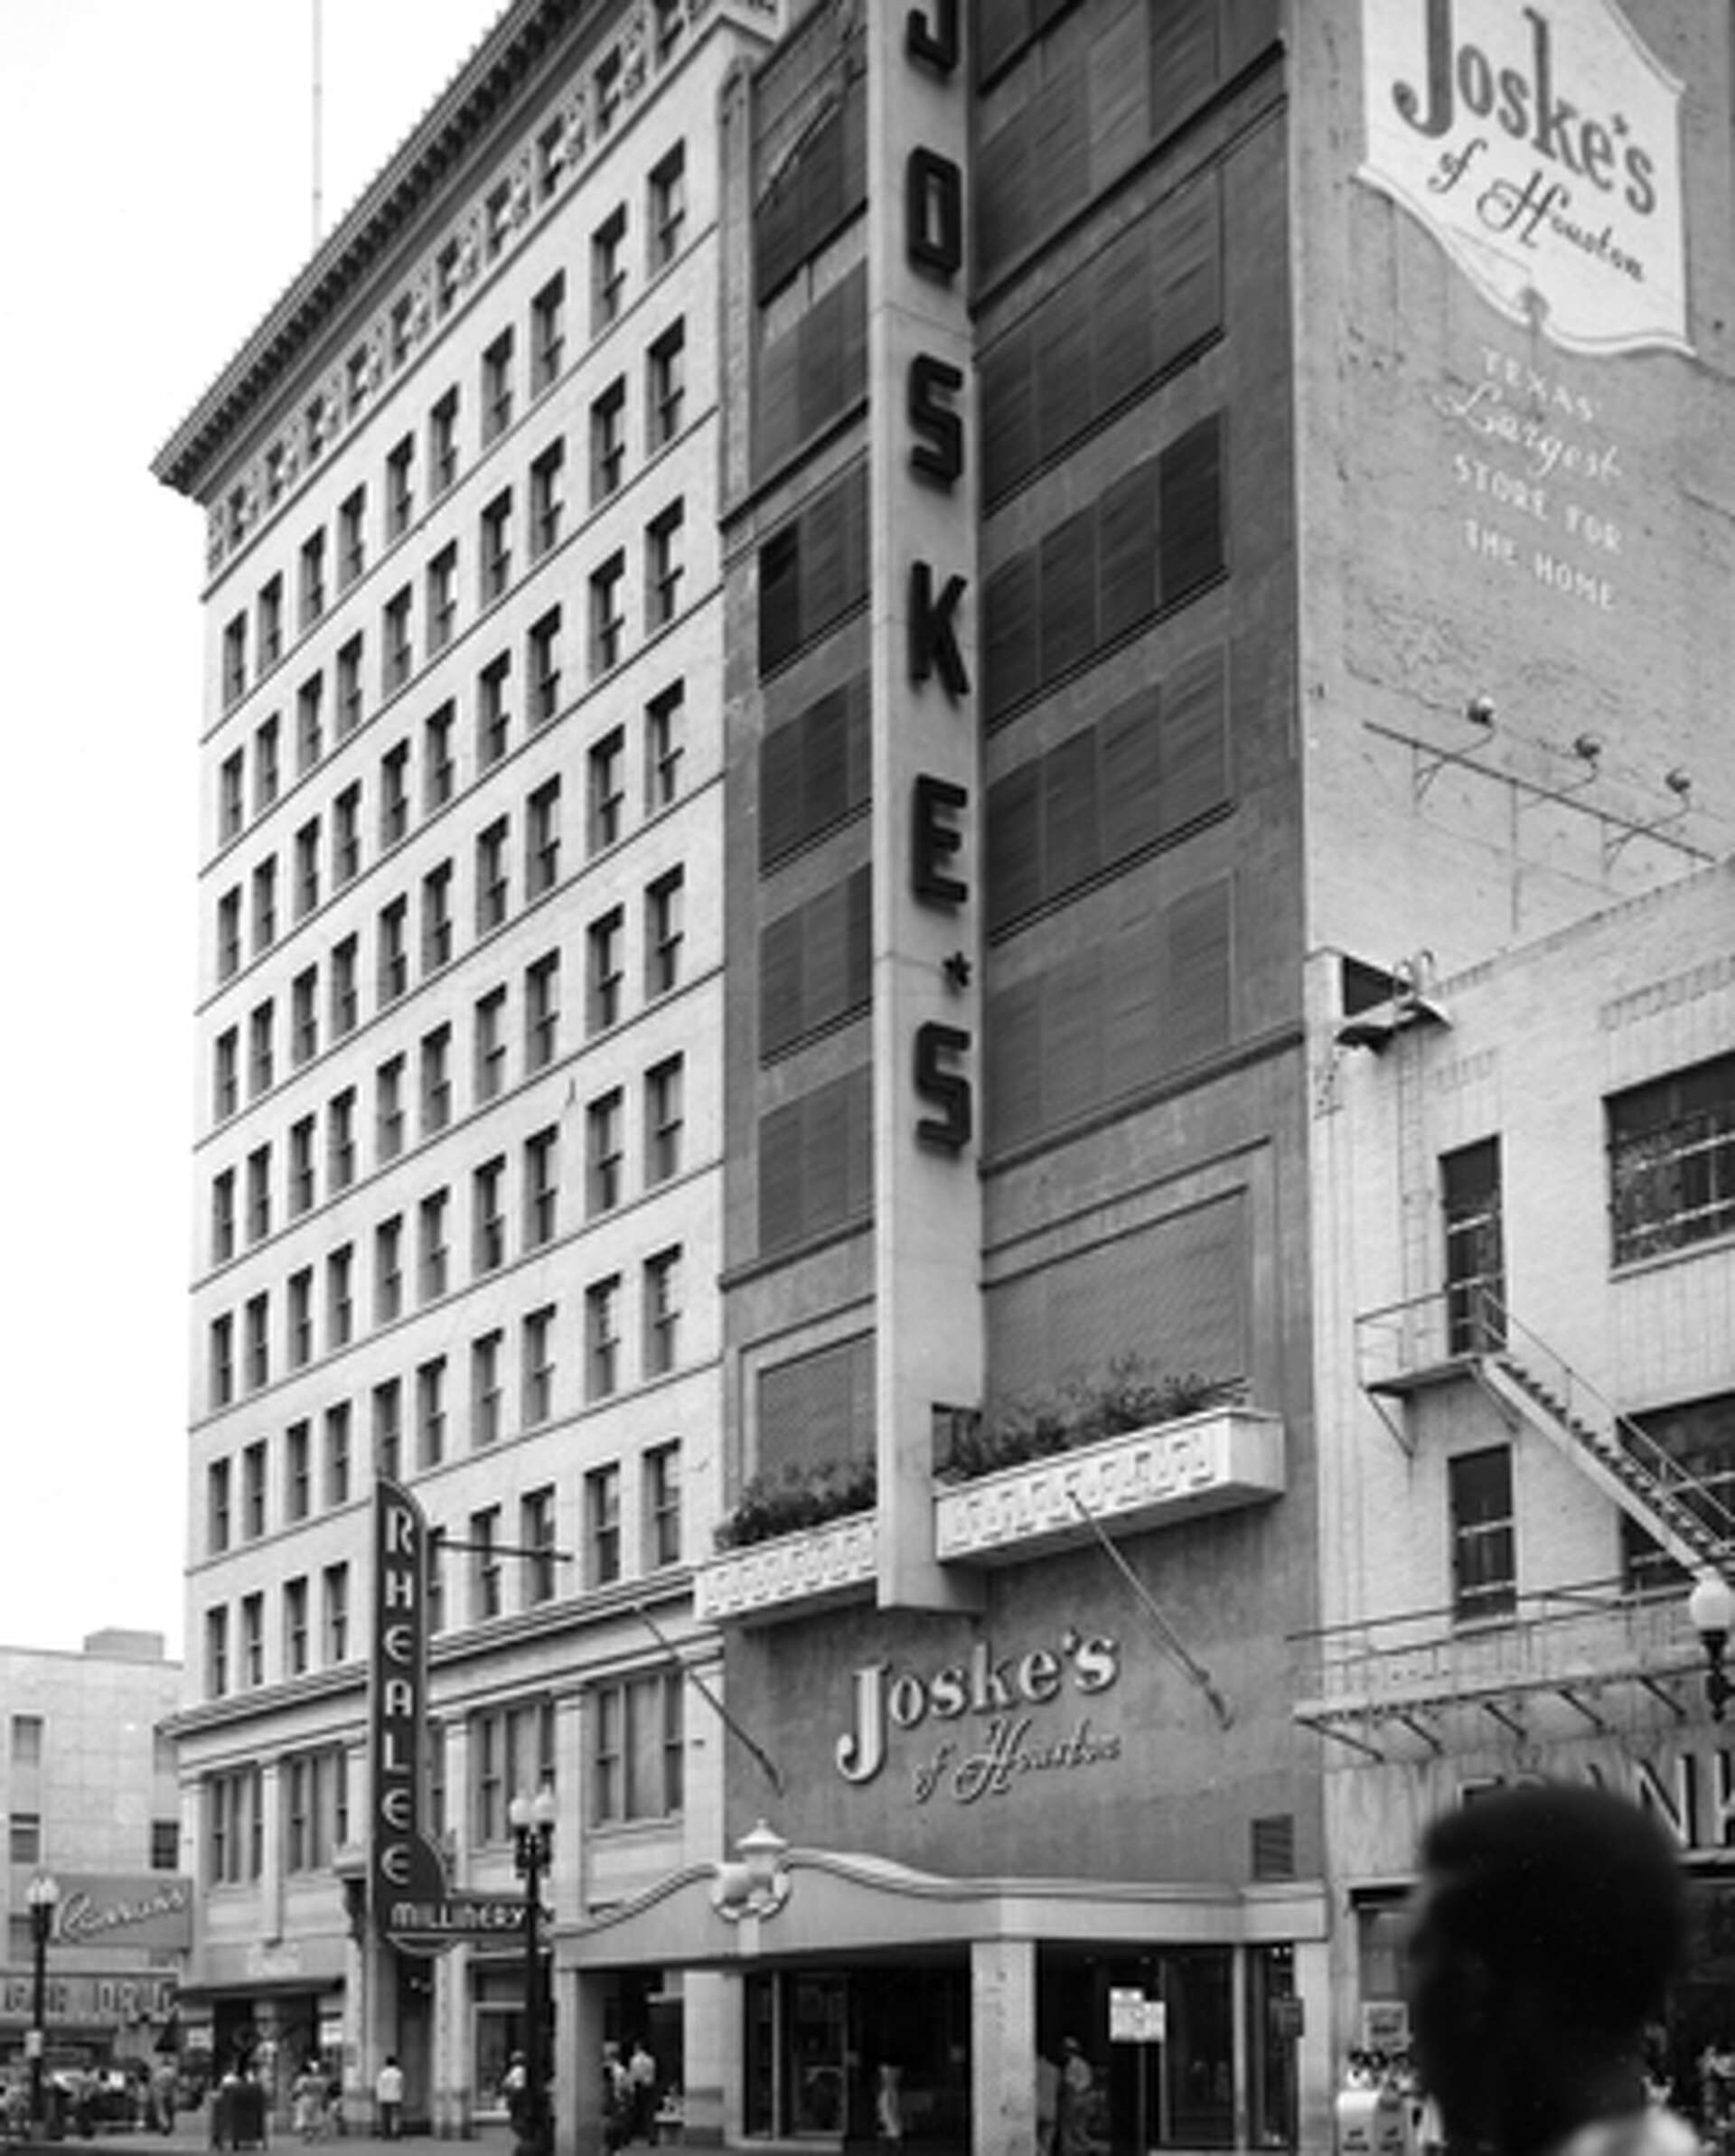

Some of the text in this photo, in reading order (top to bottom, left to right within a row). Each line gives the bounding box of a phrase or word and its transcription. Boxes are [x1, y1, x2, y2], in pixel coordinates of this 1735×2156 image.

[1393, 0, 1655, 216] Joske's
[1426, 136, 1488, 194] of
[1476, 171, 1646, 283] Houston
[1431, 381, 1624, 480] Largest
[1480, 346, 1596, 422] TEXAS
[1452, 453, 1623, 555] STORE FOR
[1464, 518, 1613, 611] THE HOME
[380, 1505, 415, 1885] RHEALEE
[836, 1626, 1121, 1786] Joske's
[914, 1716, 1123, 1804] of Houston
